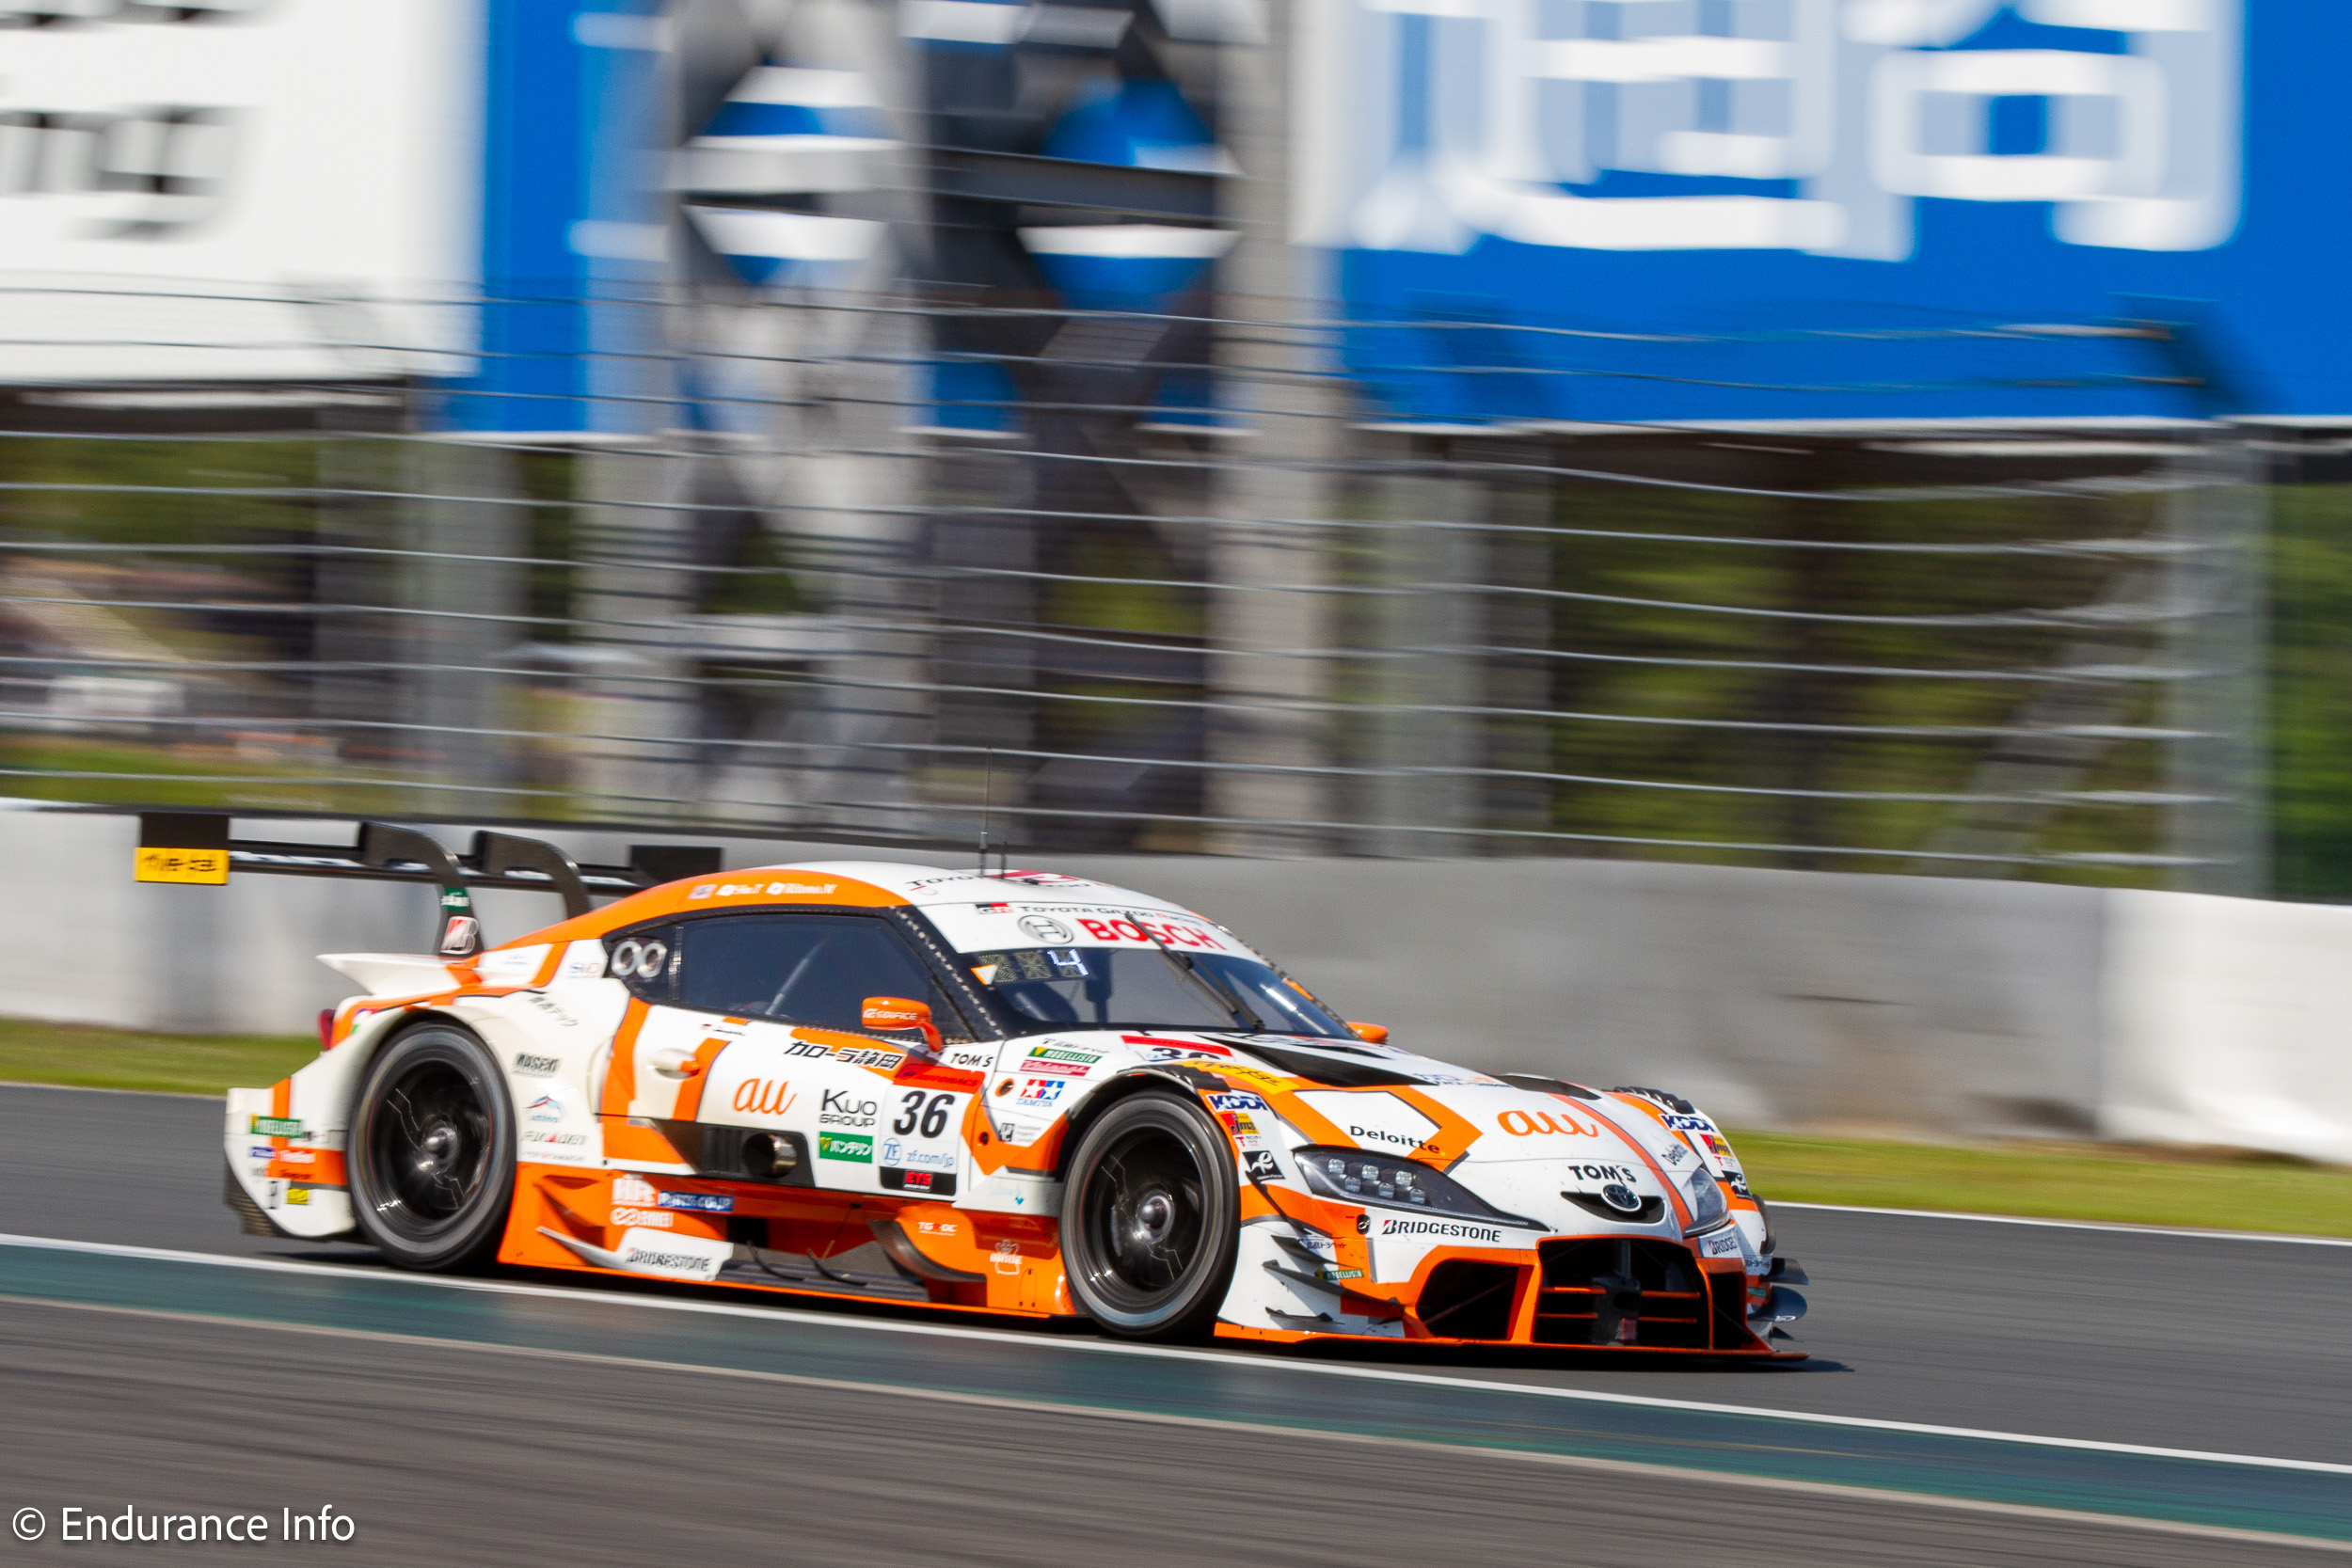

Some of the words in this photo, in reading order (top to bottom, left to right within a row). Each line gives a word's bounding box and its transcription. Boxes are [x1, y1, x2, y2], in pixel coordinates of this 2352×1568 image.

[784, 1041, 903, 1069] カローラ静岡
[948, 1053, 994, 1068] TOM'S
[732, 1078, 798, 1116] au
[821, 1088, 877, 1117] Kuo
[1208, 1095, 1268, 1111] KDDI
[819, 1114, 875, 1127] GROUP
[894, 1090, 956, 1139] 36
[1497, 1110, 1599, 1138] au
[1661, 1115, 1715, 1132] KDDI
[830, 1139, 873, 1157] バンテリン
[1349, 1125, 1440, 1154] Deloitte
[907, 1149, 955, 1168] zf.com/jp
[1567, 1164, 1637, 1183] TOM'S
[1382, 1219, 1502, 1243] BRIDGESTONE
